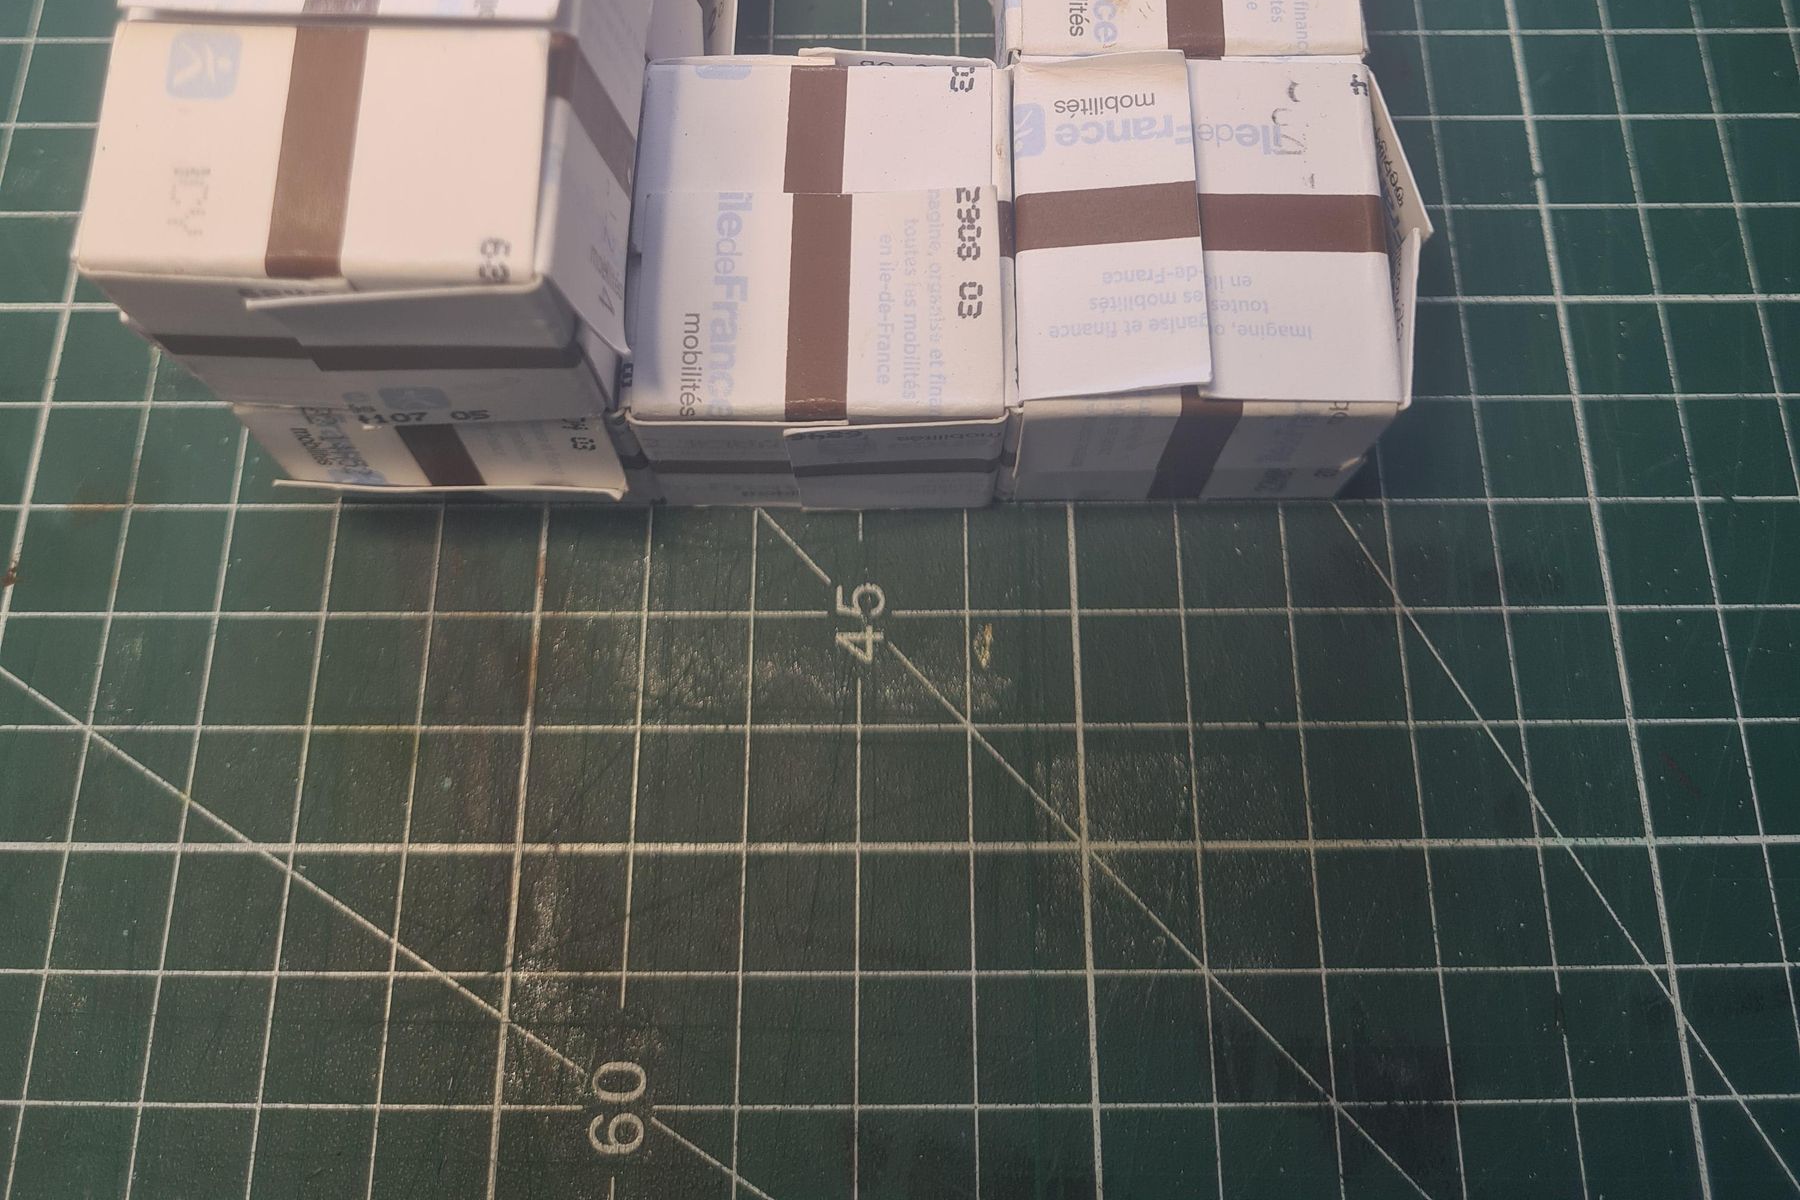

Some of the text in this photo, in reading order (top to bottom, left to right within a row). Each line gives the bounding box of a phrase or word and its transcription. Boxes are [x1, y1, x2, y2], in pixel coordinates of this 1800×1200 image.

[1053, 92, 1156, 118] mobilités
[679, 312, 703, 418] mobilités
[834, 581, 886, 664] 45
[588, 1059, 648, 1157] 60
